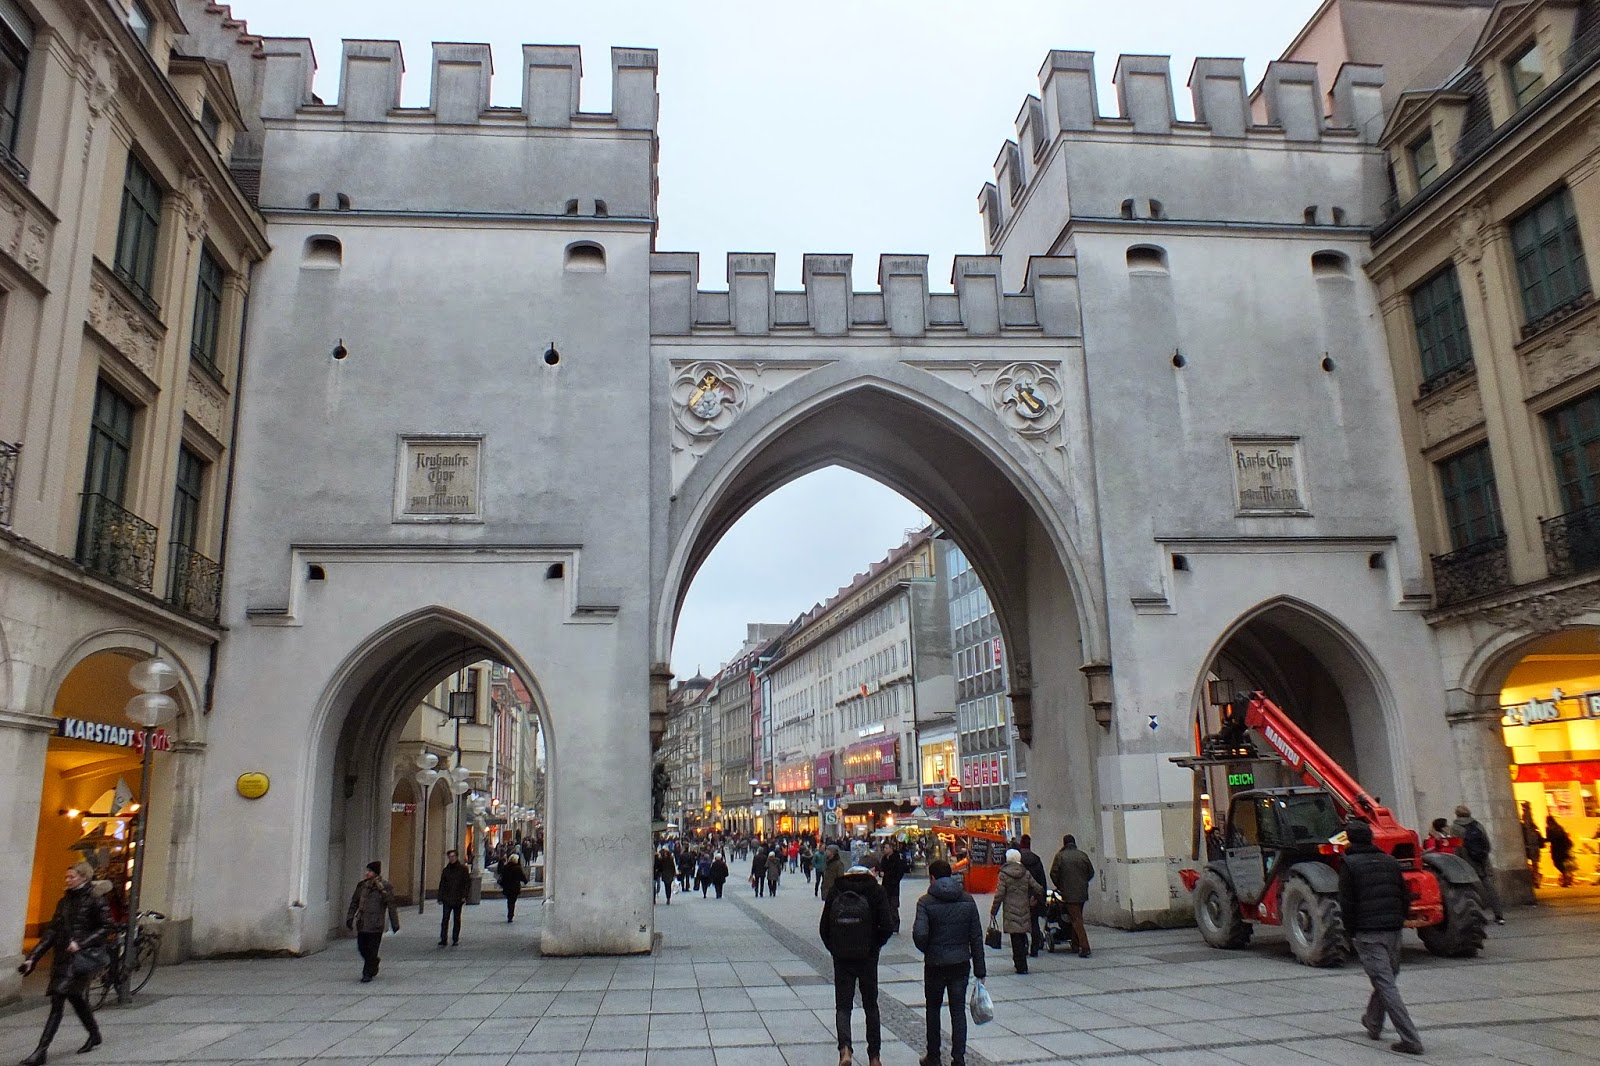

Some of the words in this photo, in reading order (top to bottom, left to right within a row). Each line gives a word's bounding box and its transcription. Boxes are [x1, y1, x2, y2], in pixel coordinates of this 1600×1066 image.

[1266, 449, 1293, 471] Thor
[427, 467, 455, 482] Thor
[64, 717, 134, 747] KARSTADT
[1265, 725, 1300, 766] MANITOU
[1228, 773, 1254, 786] DEICH
[827, 799, 837, 810] U
[828, 812, 837, 824] S
